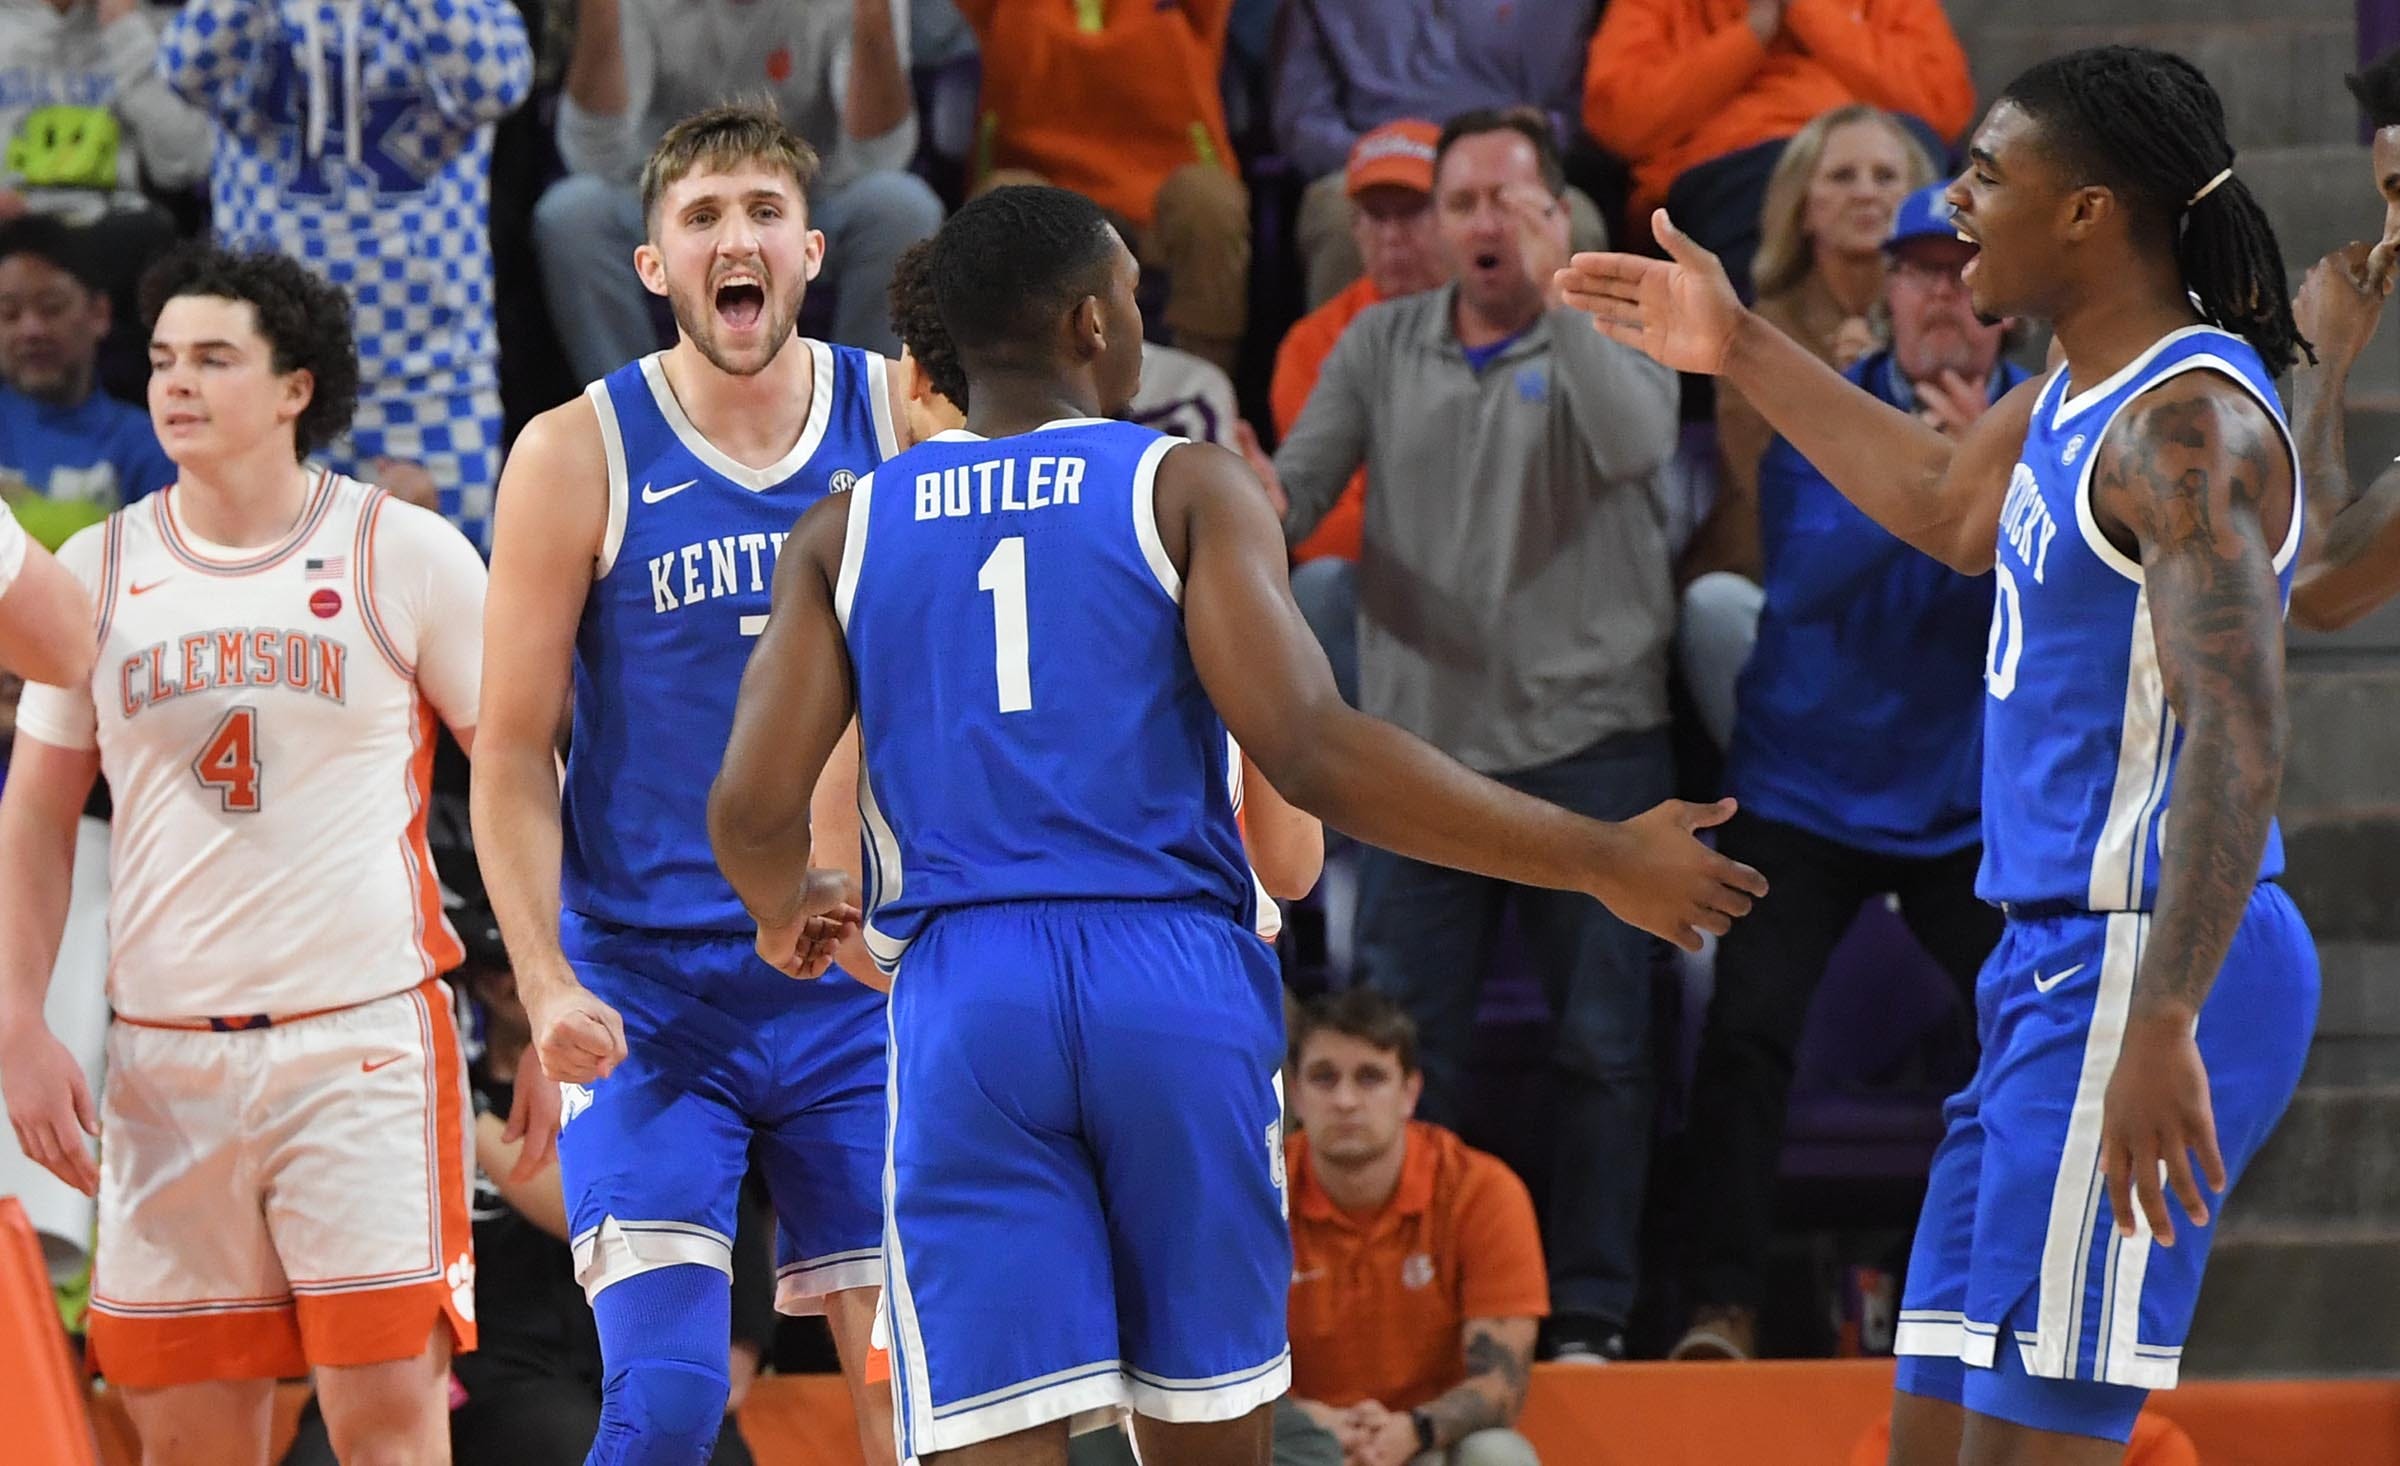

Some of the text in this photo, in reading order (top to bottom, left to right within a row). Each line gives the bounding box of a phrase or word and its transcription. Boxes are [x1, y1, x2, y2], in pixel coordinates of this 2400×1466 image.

[915, 456, 1086, 521] BUTLER
[648, 532, 792, 614] KENT
[120, 626, 347, 720] CLEMSON
[977, 536, 1032, 713] 1
[1985, 552, 2024, 701] 0
[191, 705, 262, 813] 4
